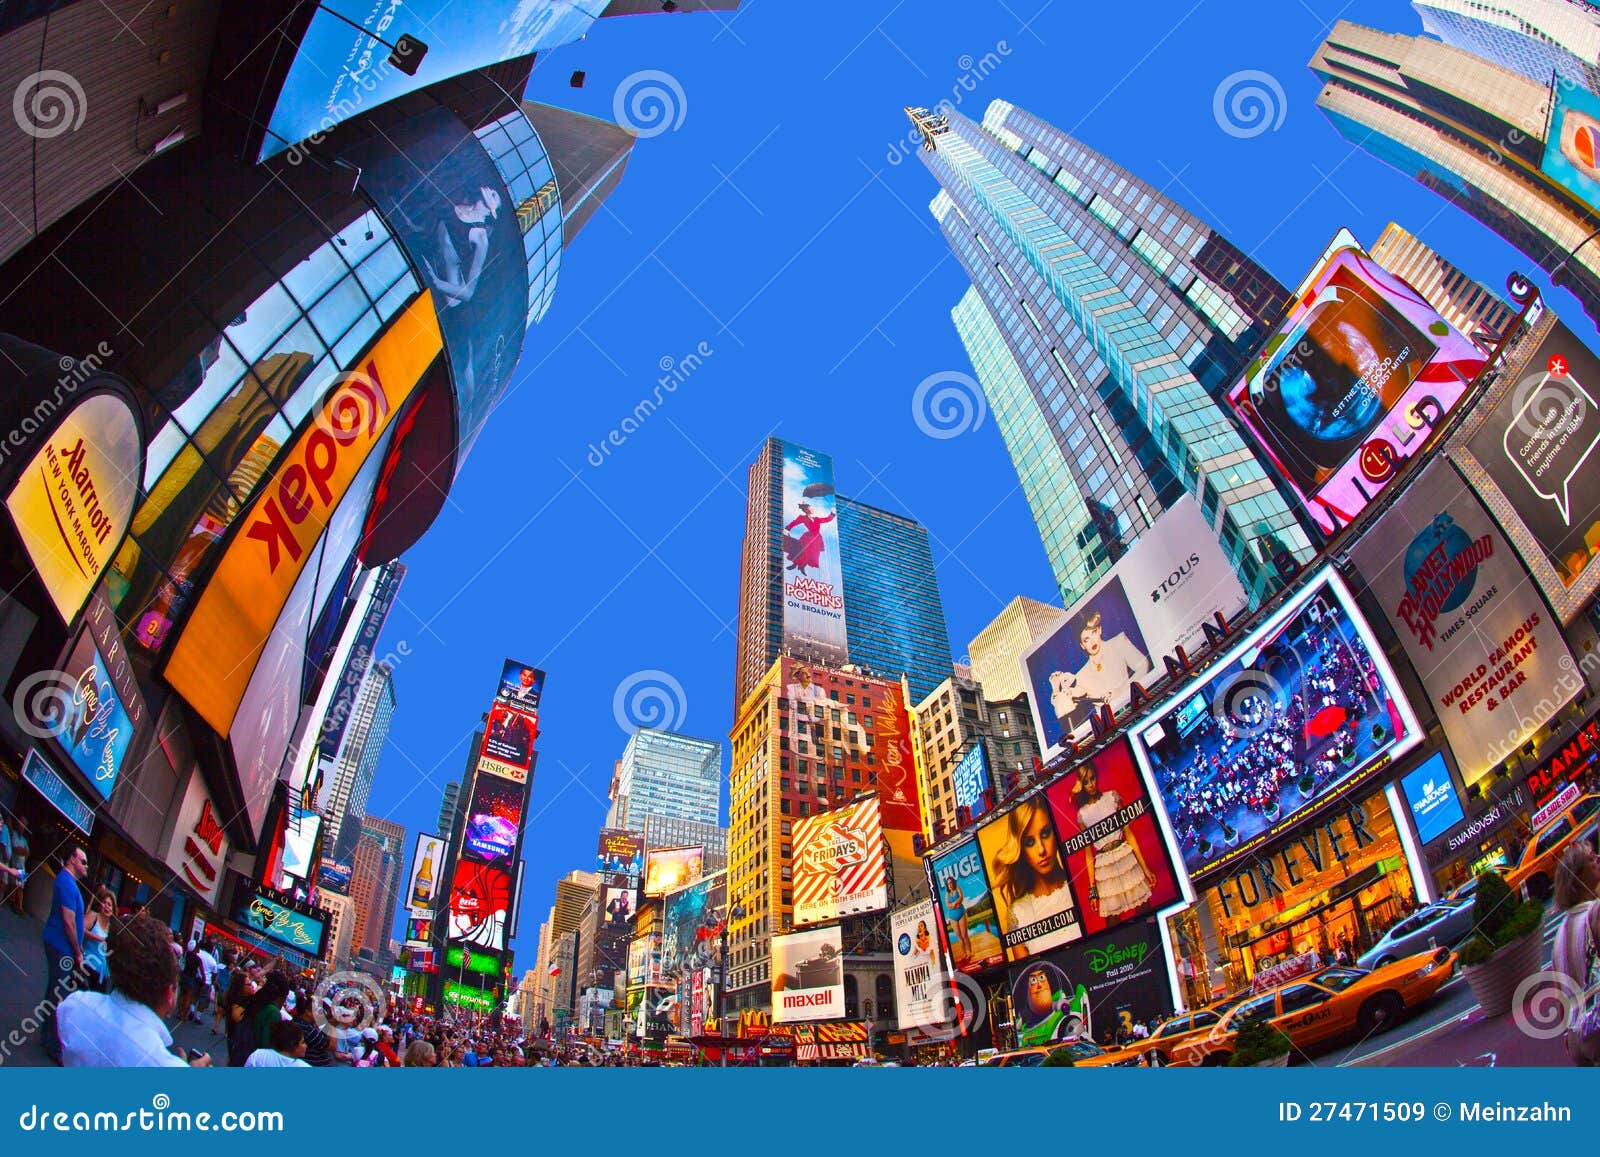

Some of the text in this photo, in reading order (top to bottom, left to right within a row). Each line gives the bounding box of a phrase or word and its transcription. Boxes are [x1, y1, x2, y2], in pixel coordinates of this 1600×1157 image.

[1332, 358, 1380, 417] IS IT THE TRIUMPH
[1359, 356, 1393, 396] OF GOOD
[1361, 345, 1412, 409] OVER DUST MITES?
[1520, 407, 1557, 457] Connect with
[1527, 437, 1550, 467] friends
[1548, 429, 1556, 441] in
[246, 361, 390, 575] Kodak
[1536, 441, 1562, 477] anytime
[1559, 432, 1569, 446] on
[45, 443, 100, 576] NEW YORK MARQUIS
[61, 438, 113, 545] Marriott
[795, 576, 833, 597] MARY
[1159, 552, 1200, 594] TOUS
[1395, 539, 1448, 637] PLANET
[1415, 533, 1494, 651] HOLLYWOOD
[786, 583, 843, 609] POPPINS
[787, 601, 841, 619] ON BROADWAY
[1439, 584, 1498, 643] TIMES SQUARE
[92, 599, 144, 721] MARQUIS
[1440, 612, 1541, 708] WORLD FAMOUS
[1459, 635, 1540, 715] RESTAURANT
[1486, 670, 1527, 712] & BAR
[482, 759, 510, 776] HSBC
[1528, 722, 1599, 795] PLANET
[955, 768, 984, 807] BEST
[1065, 801, 1145, 855] FOREVER21.COM
[1449, 807, 1500, 850] SWAROVSKI
[937, 853, 981, 888] HUGE
[1218, 806, 1374, 917] FOREVER
[800, 903, 817, 911] HERE
[849, 889, 874, 901] STREET
[1005, 909, 1075, 946] FOREVER21.COM
[905, 964, 931, 987] MAMMA
[1106, 963, 1134, 978] Fall 2010
[783, 990, 832, 1009] maxell
